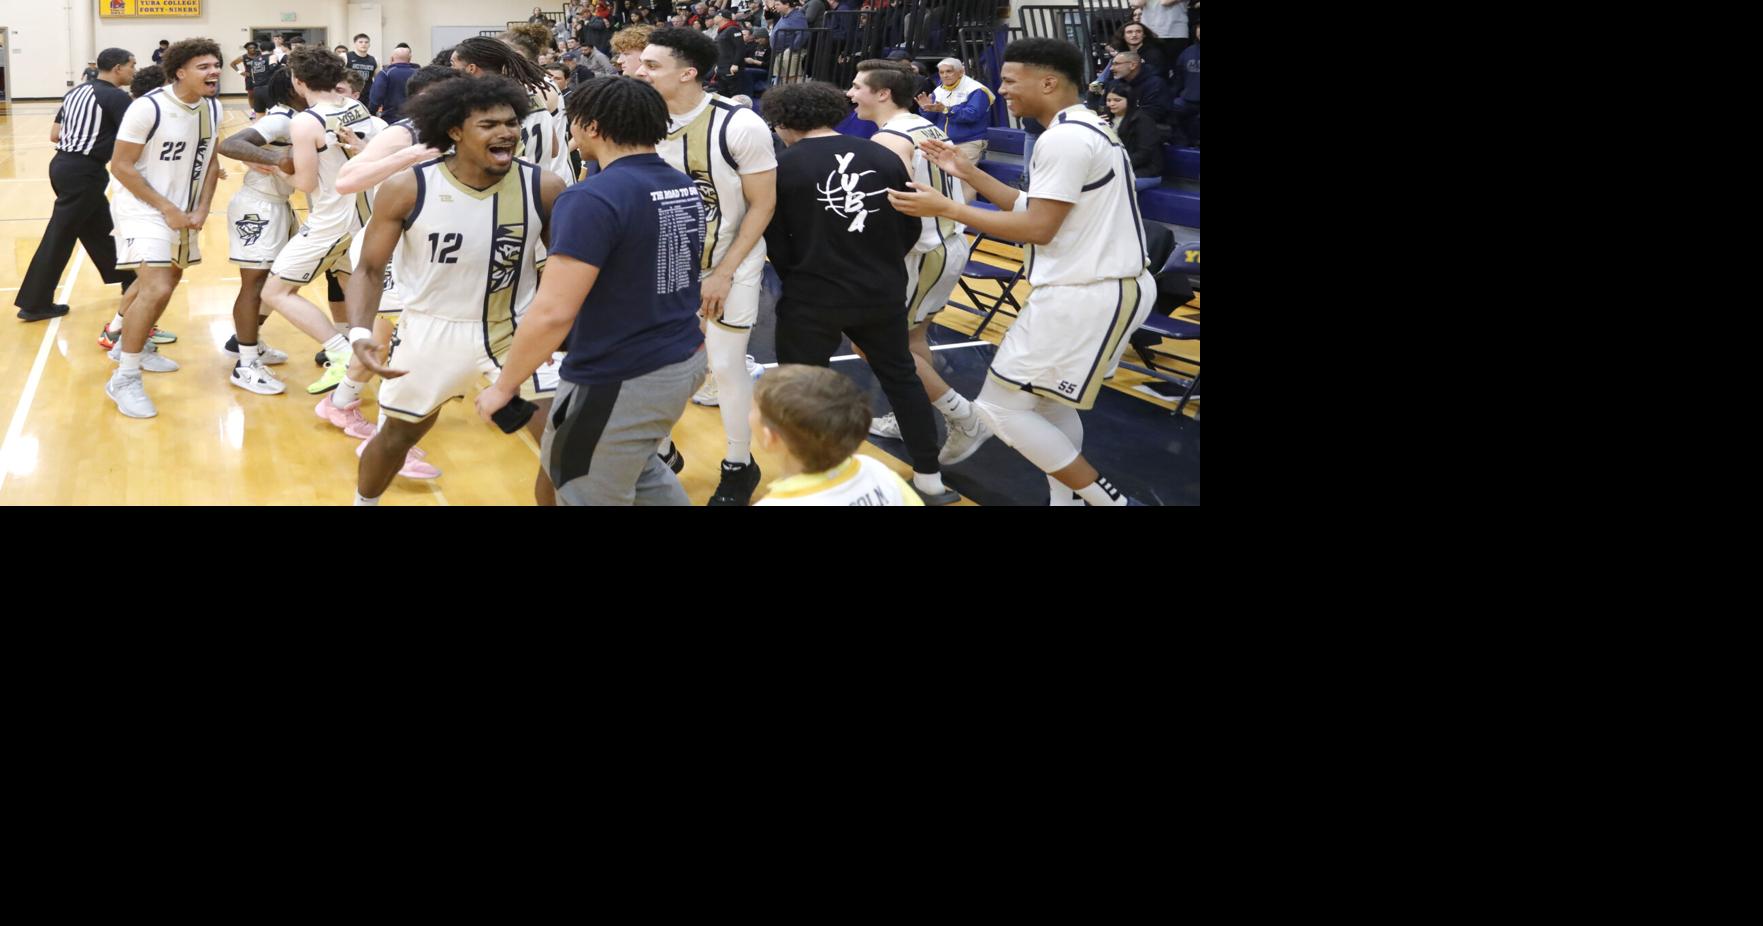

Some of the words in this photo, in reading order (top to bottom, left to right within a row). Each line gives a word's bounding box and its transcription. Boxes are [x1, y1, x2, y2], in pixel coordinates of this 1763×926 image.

[159, 141, 186, 162] 22
[679, 187, 689, 197] TO
[834, 151, 869, 233] YUBA
[428, 232, 463, 264] 12
[1057, 380, 1078, 395] 55
[848, 484, 890, 506] OLN
